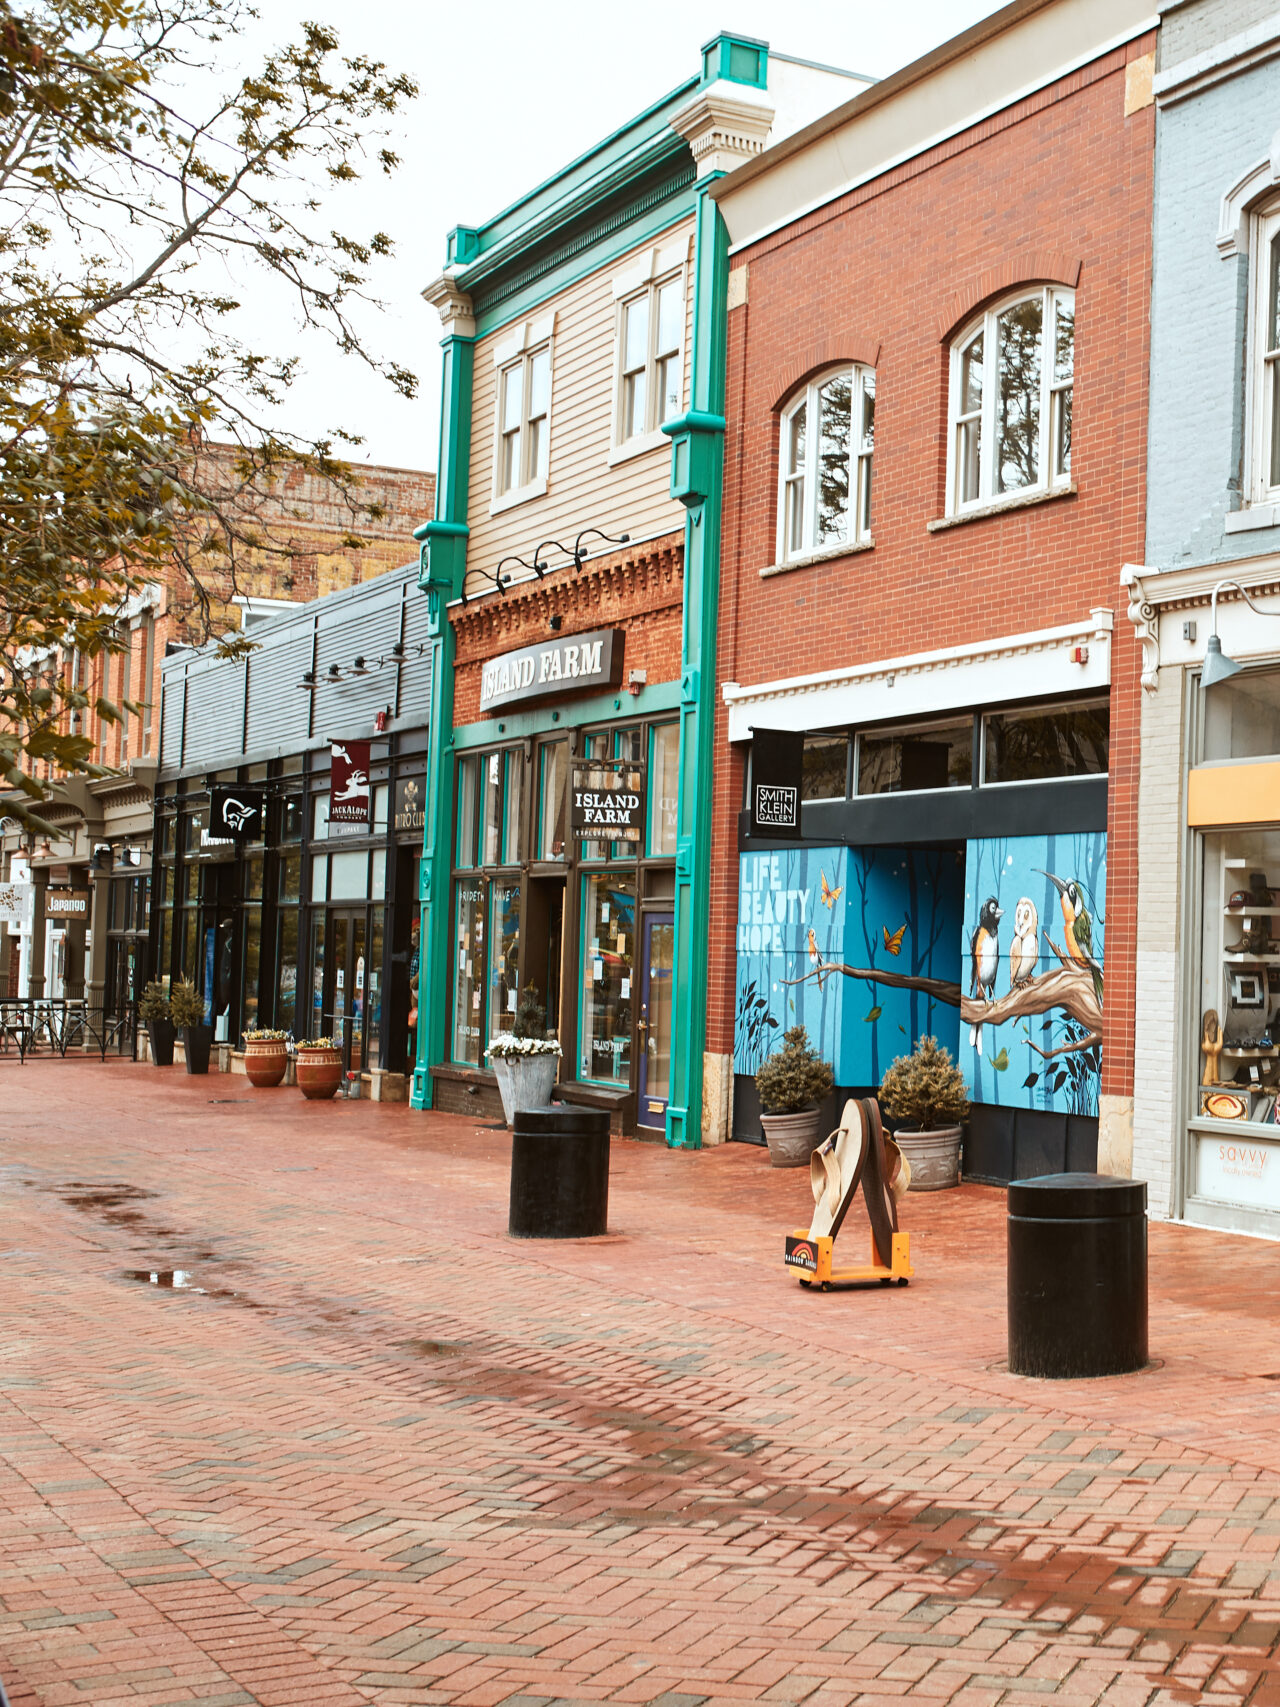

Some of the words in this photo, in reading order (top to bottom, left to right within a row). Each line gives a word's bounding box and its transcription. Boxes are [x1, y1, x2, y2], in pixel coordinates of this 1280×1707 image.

[482, 655, 536, 701] ISLAND
[538, 641, 604, 684] FARM
[575, 793, 640, 809] ISLAND
[759, 788, 794, 803] SMITH
[331, 805, 368, 816] JACKALOPE
[759, 801, 793, 815] KLEIN
[583, 809, 631, 824] FARM
[758, 813, 793, 823] GALLERY
[741, 855, 782, 892] LIFE
[47, 896, 86, 912] Japango
[740, 888, 811, 924] BEAUTY
[738, 924, 784, 957] HOPE
[1219, 1145, 1267, 1169] savvy
[785, 1254, 804, 1265] RAINBOW
